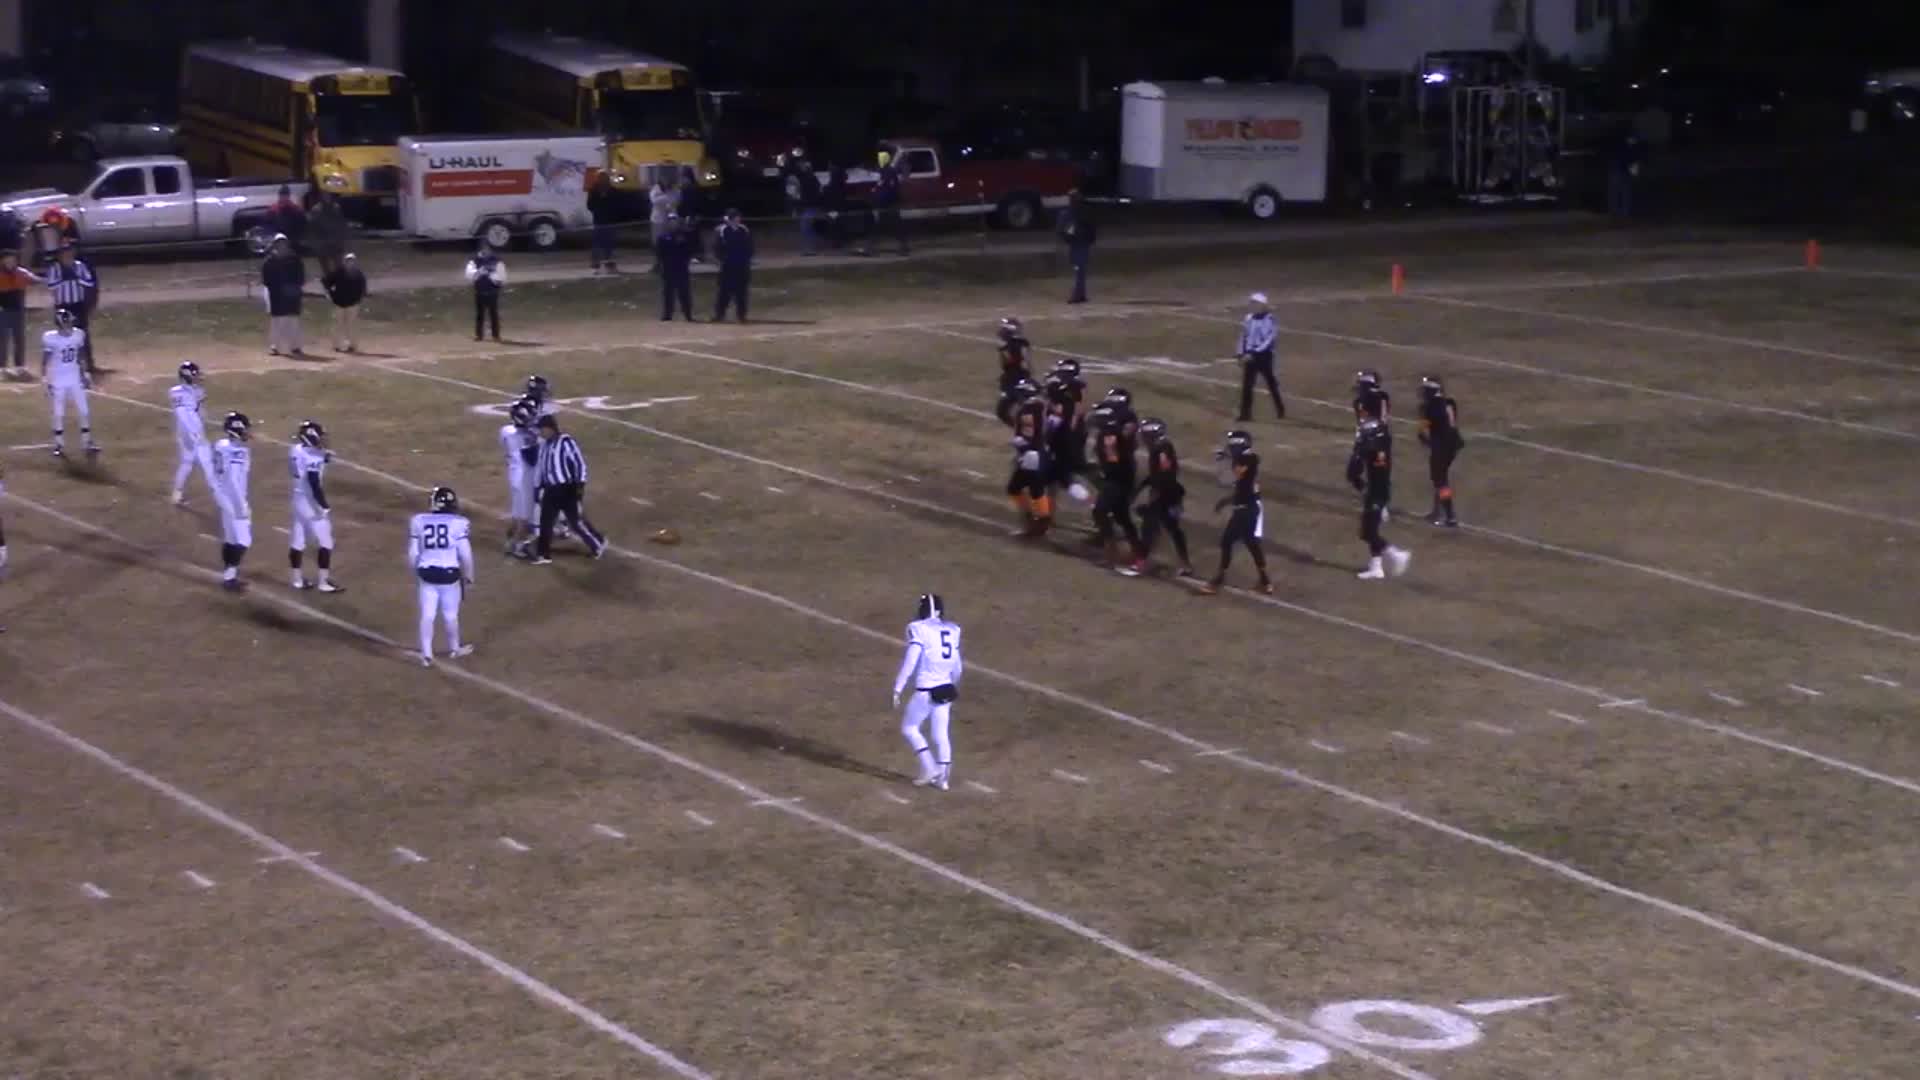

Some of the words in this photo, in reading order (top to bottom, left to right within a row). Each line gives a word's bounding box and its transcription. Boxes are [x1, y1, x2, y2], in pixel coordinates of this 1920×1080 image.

[429, 156, 503, 169] U-HAUL
[423, 523, 449, 549] 28
[940, 630, 952, 659] 5
[1164, 1000, 1485, 1075] 30
